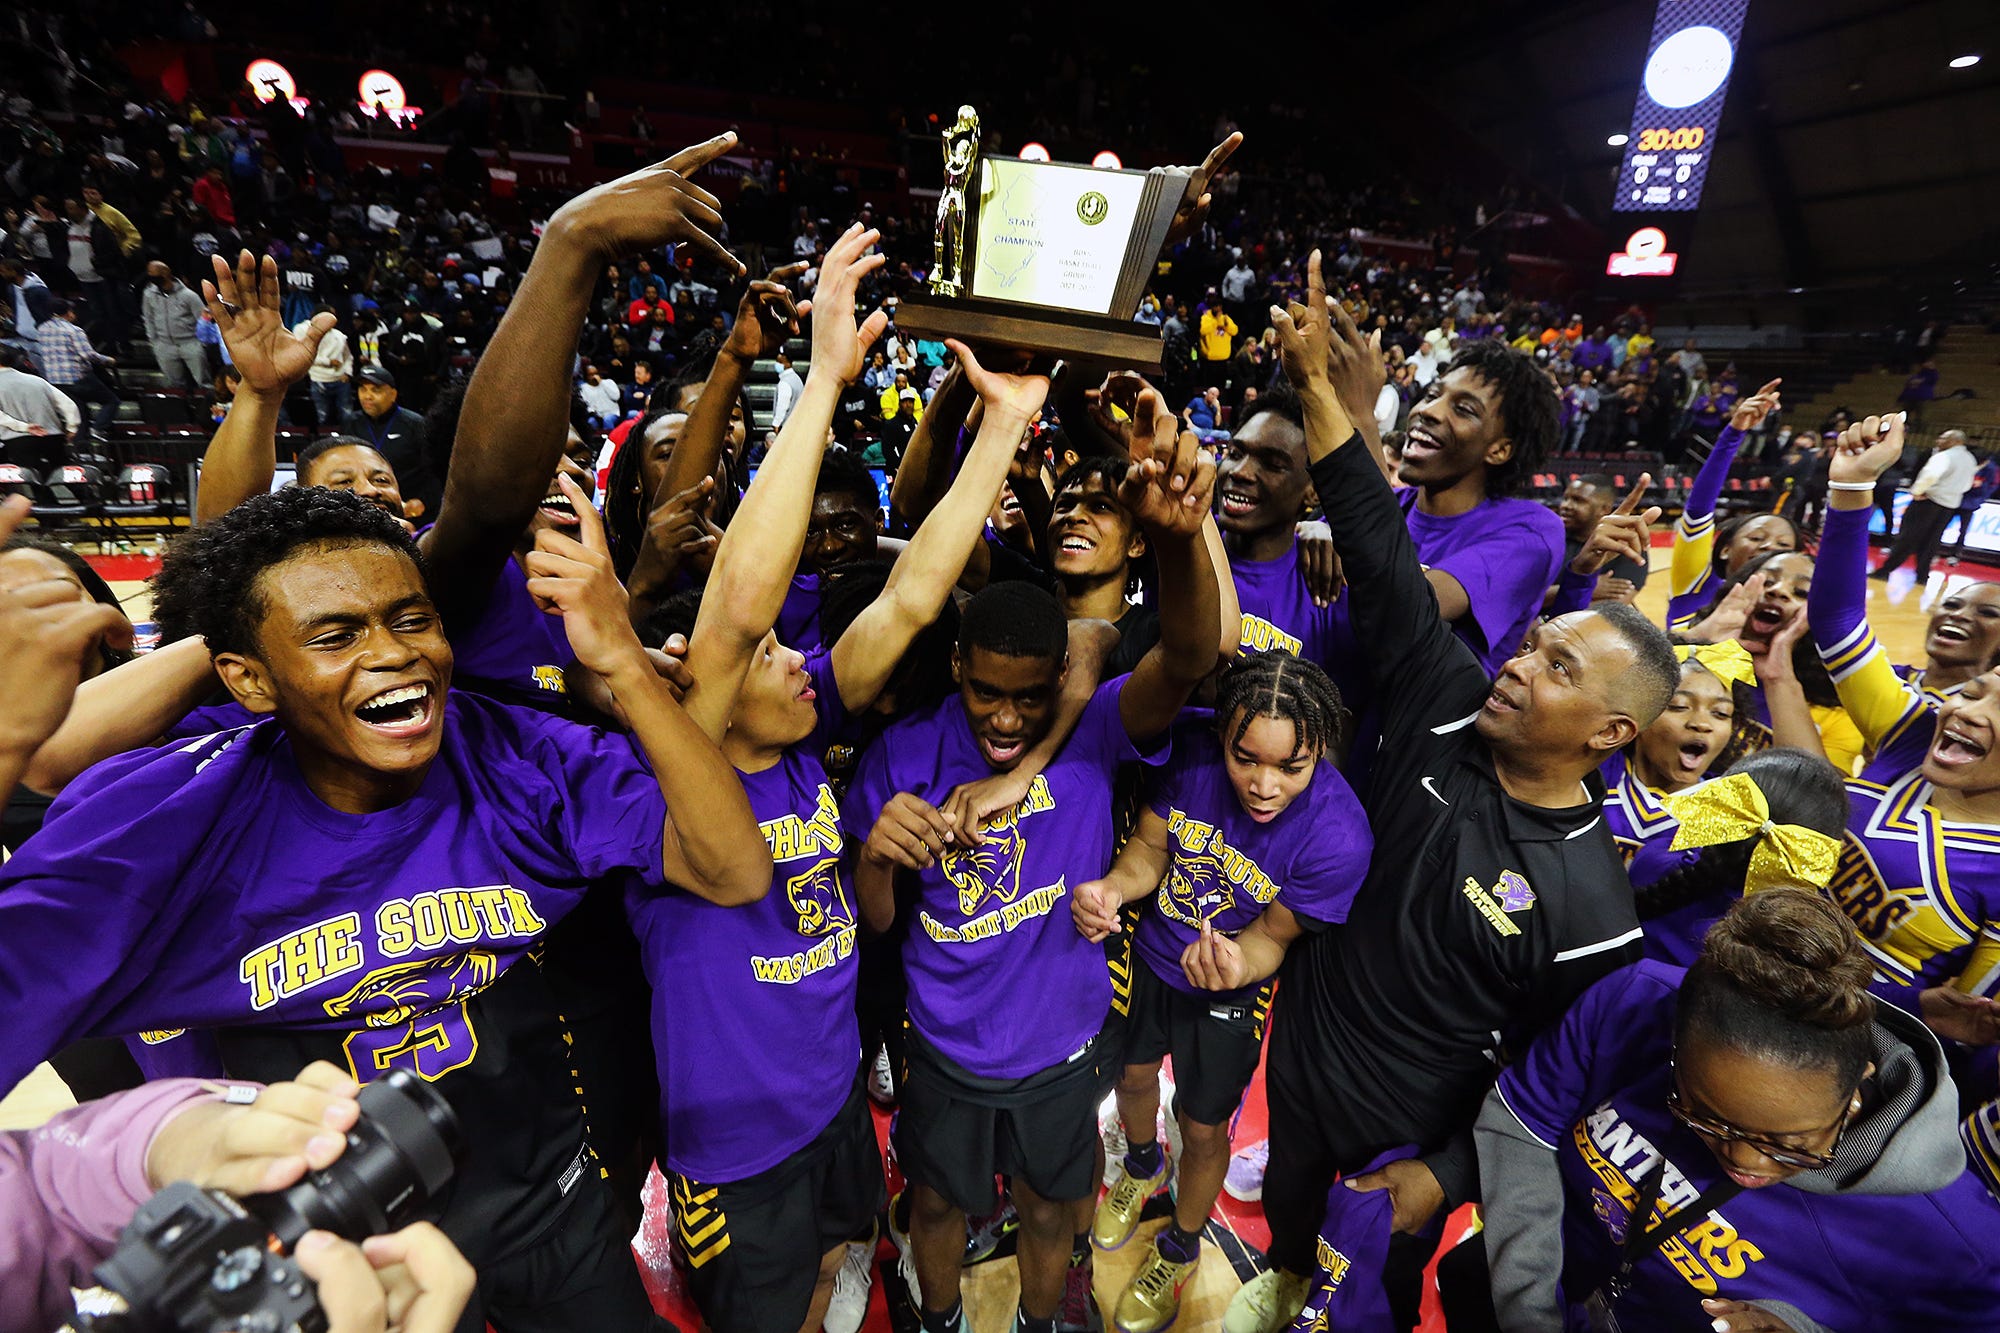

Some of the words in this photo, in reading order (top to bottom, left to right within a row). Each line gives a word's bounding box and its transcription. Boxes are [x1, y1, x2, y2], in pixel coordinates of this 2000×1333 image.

[1638, 127, 1704, 152] 30:00
[536, 168, 567, 185] 114
[286, 270, 314, 288] VOTE
[1239, 613, 1303, 658] OUTH
[959, 910, 1001, 942] NOT
[241, 912, 363, 1011] THE
[375, 886, 545, 958] SOUTH
[751, 953, 805, 984] WAS
[1587, 1102, 1765, 1279] ANTHRS
